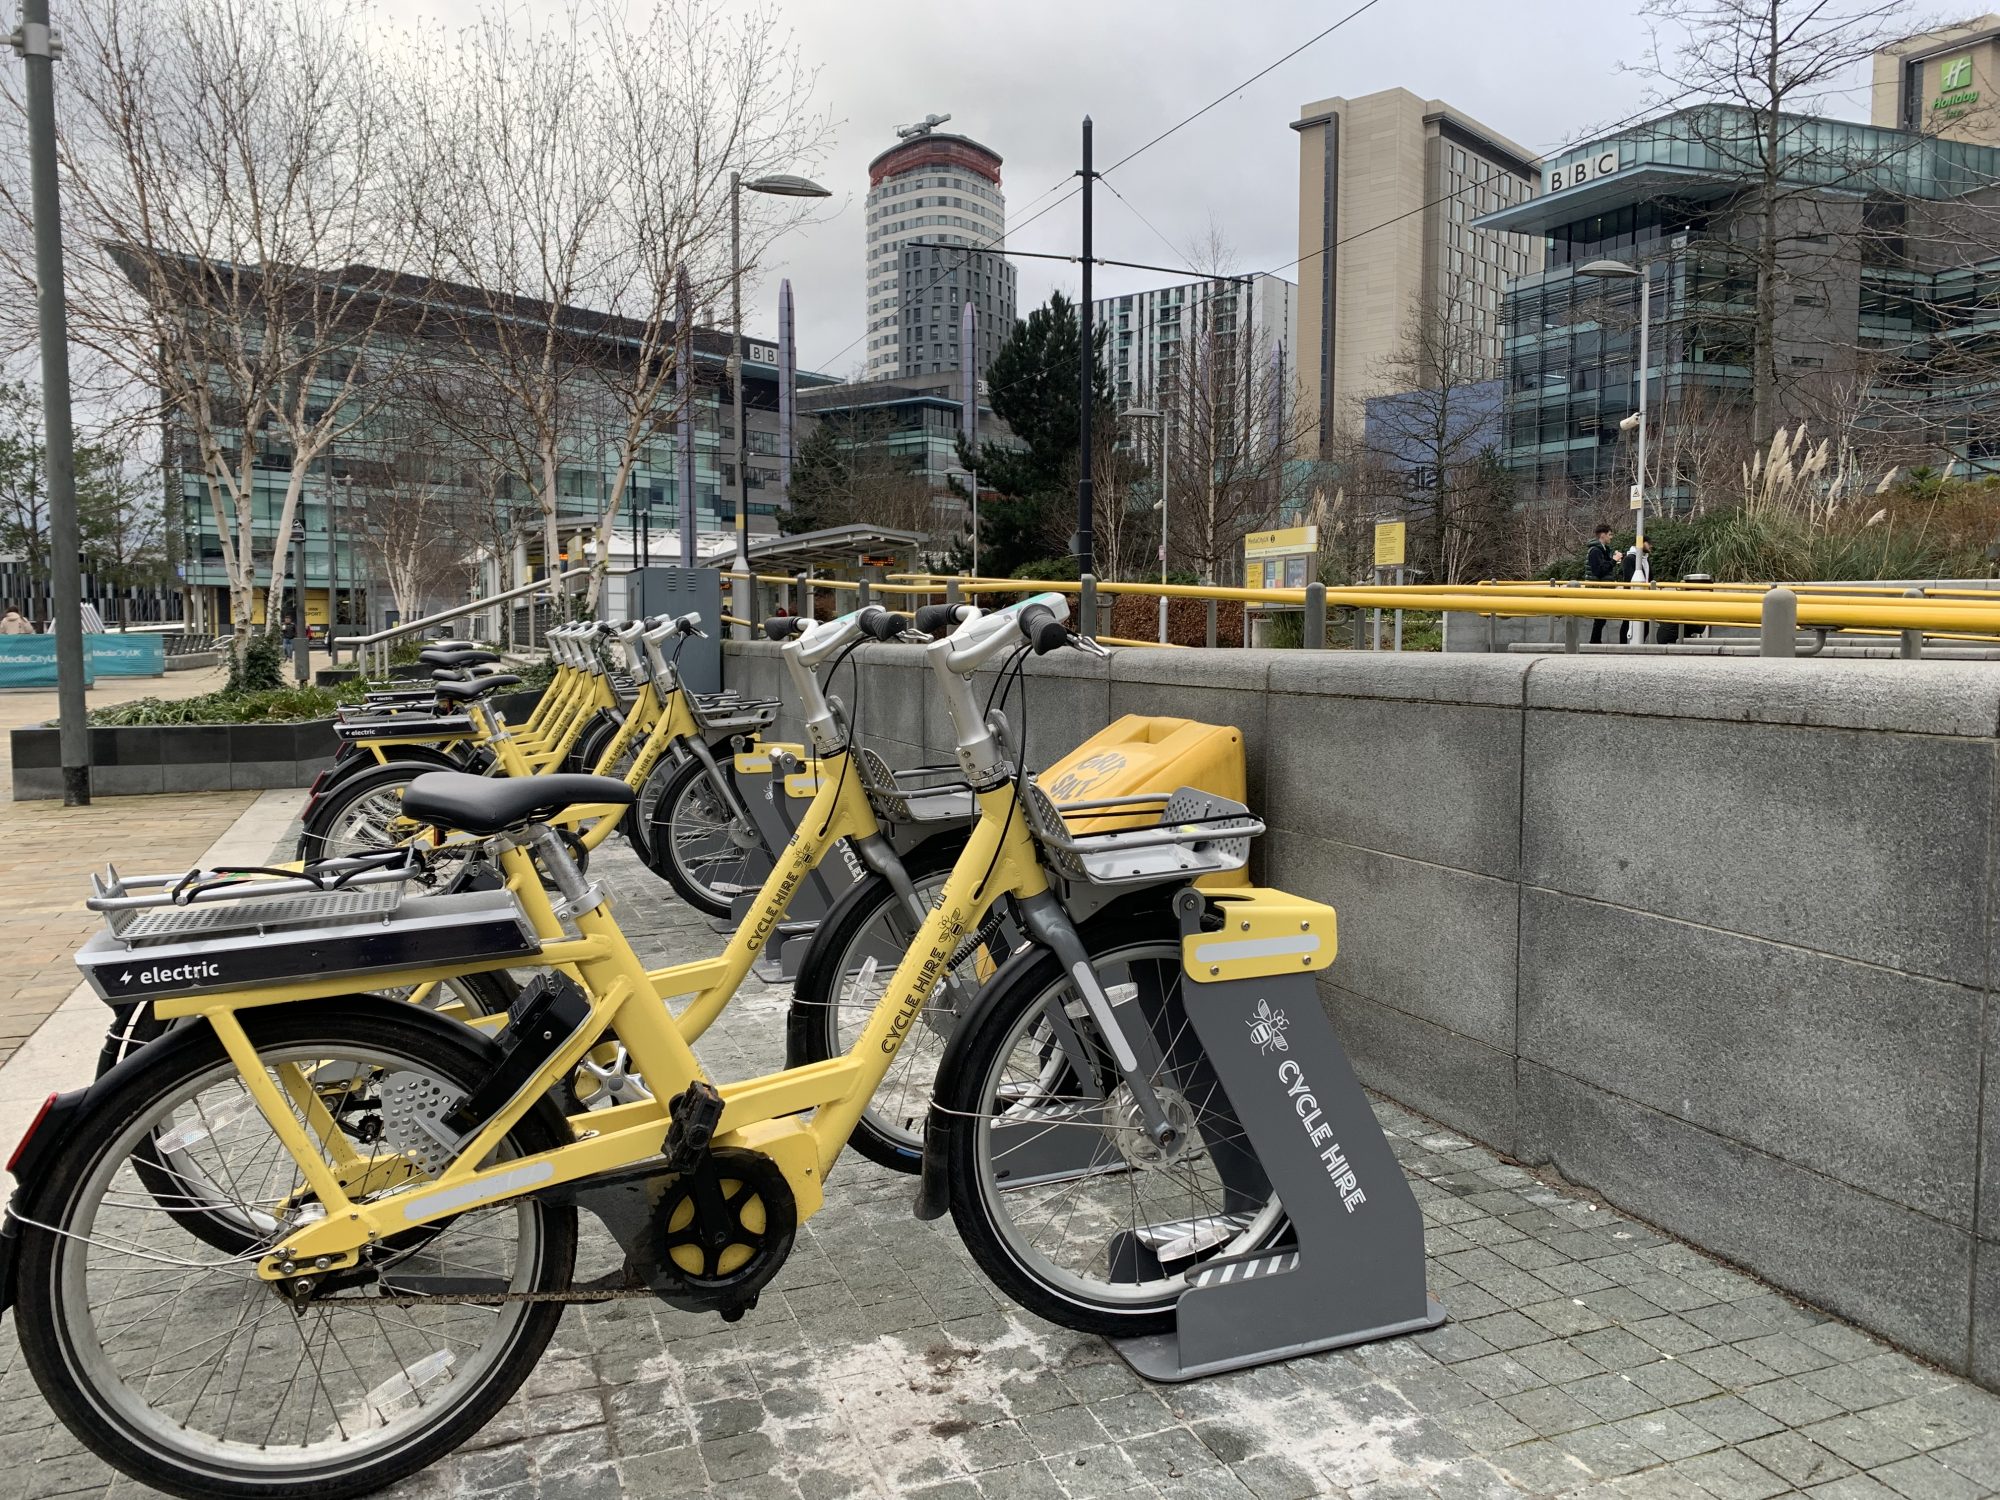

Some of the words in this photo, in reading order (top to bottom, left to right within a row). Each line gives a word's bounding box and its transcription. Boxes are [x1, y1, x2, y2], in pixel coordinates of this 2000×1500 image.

[1932, 91, 1979, 110] Holiday
[1551, 153, 1614, 192] BBC
[753, 346, 775, 362] BB
[92, 649, 141, 659] MediaCityUK
[350, 728, 376, 737] electric
[612, 740, 626, 758] HIRE
[640, 753, 654, 771] HIRE
[1050, 773, 1099, 801] SALT
[746, 905, 779, 951] CYCLE
[771, 871, 800, 906] HIRE
[140, 960, 220, 985] electric
[881, 993, 922, 1054] CYCLE
[912, 946, 947, 994] HIRE
[1278, 1059, 1334, 1148] CYCLE
[1320, 1143, 1367, 1214] HIRE
